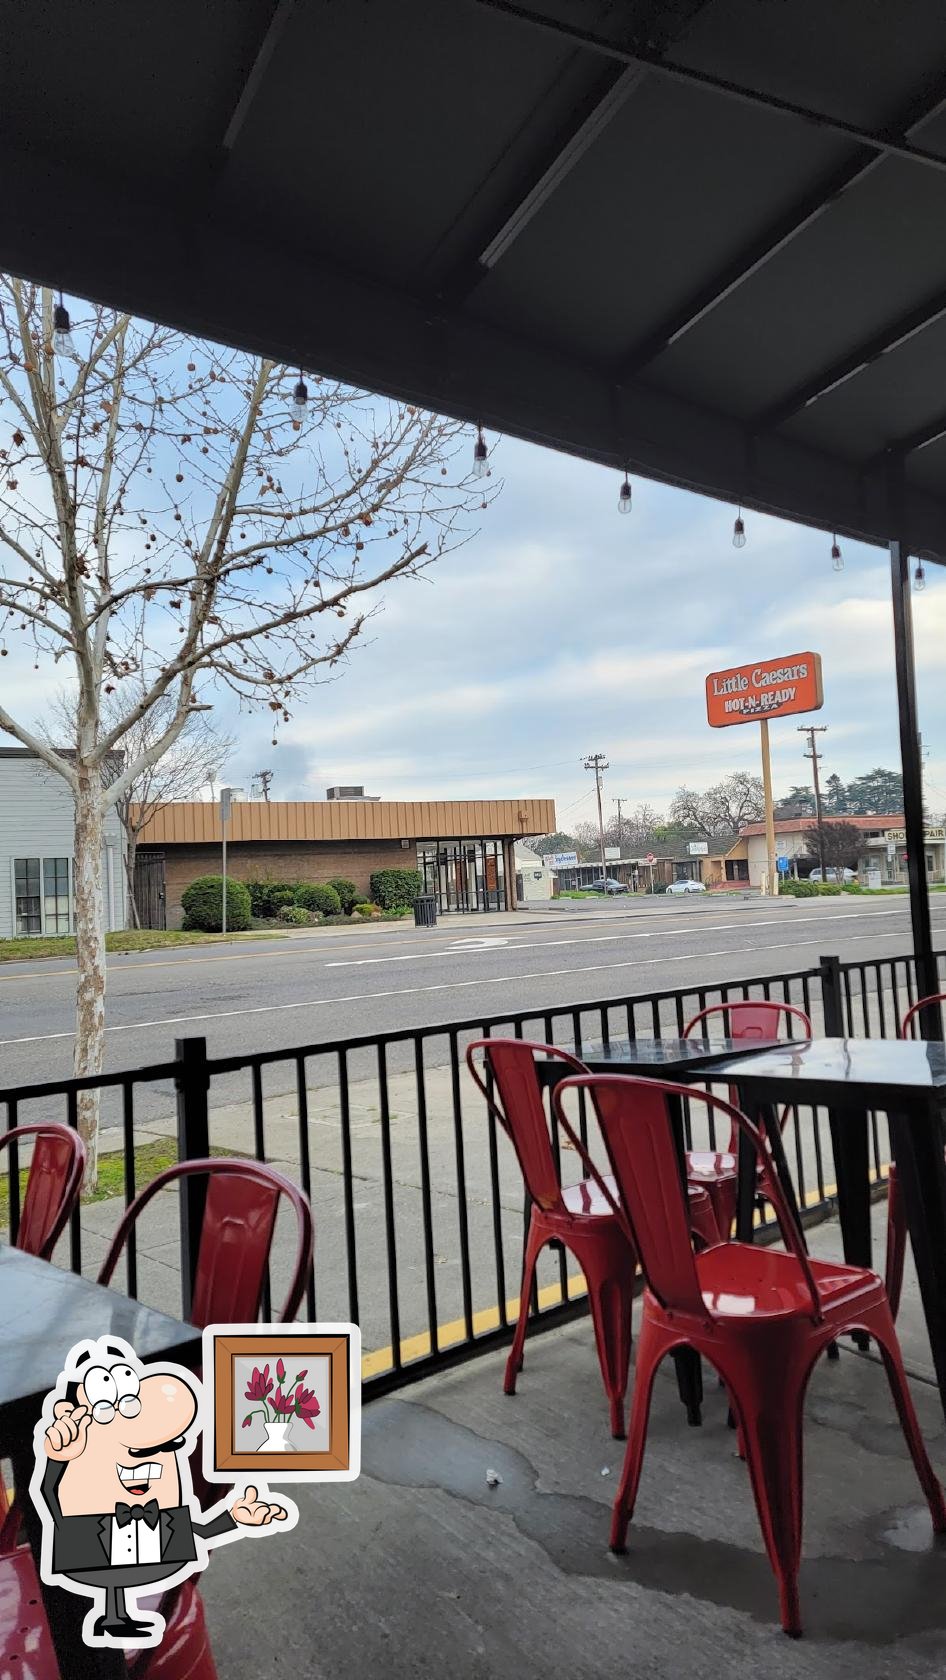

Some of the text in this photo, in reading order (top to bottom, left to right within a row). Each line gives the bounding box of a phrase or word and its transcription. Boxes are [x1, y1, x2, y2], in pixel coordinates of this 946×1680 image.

[713, 664, 807, 695] Little Caesars
[724, 687, 797, 713] HOT-N-READY
[887, 832, 905, 840] SHO
